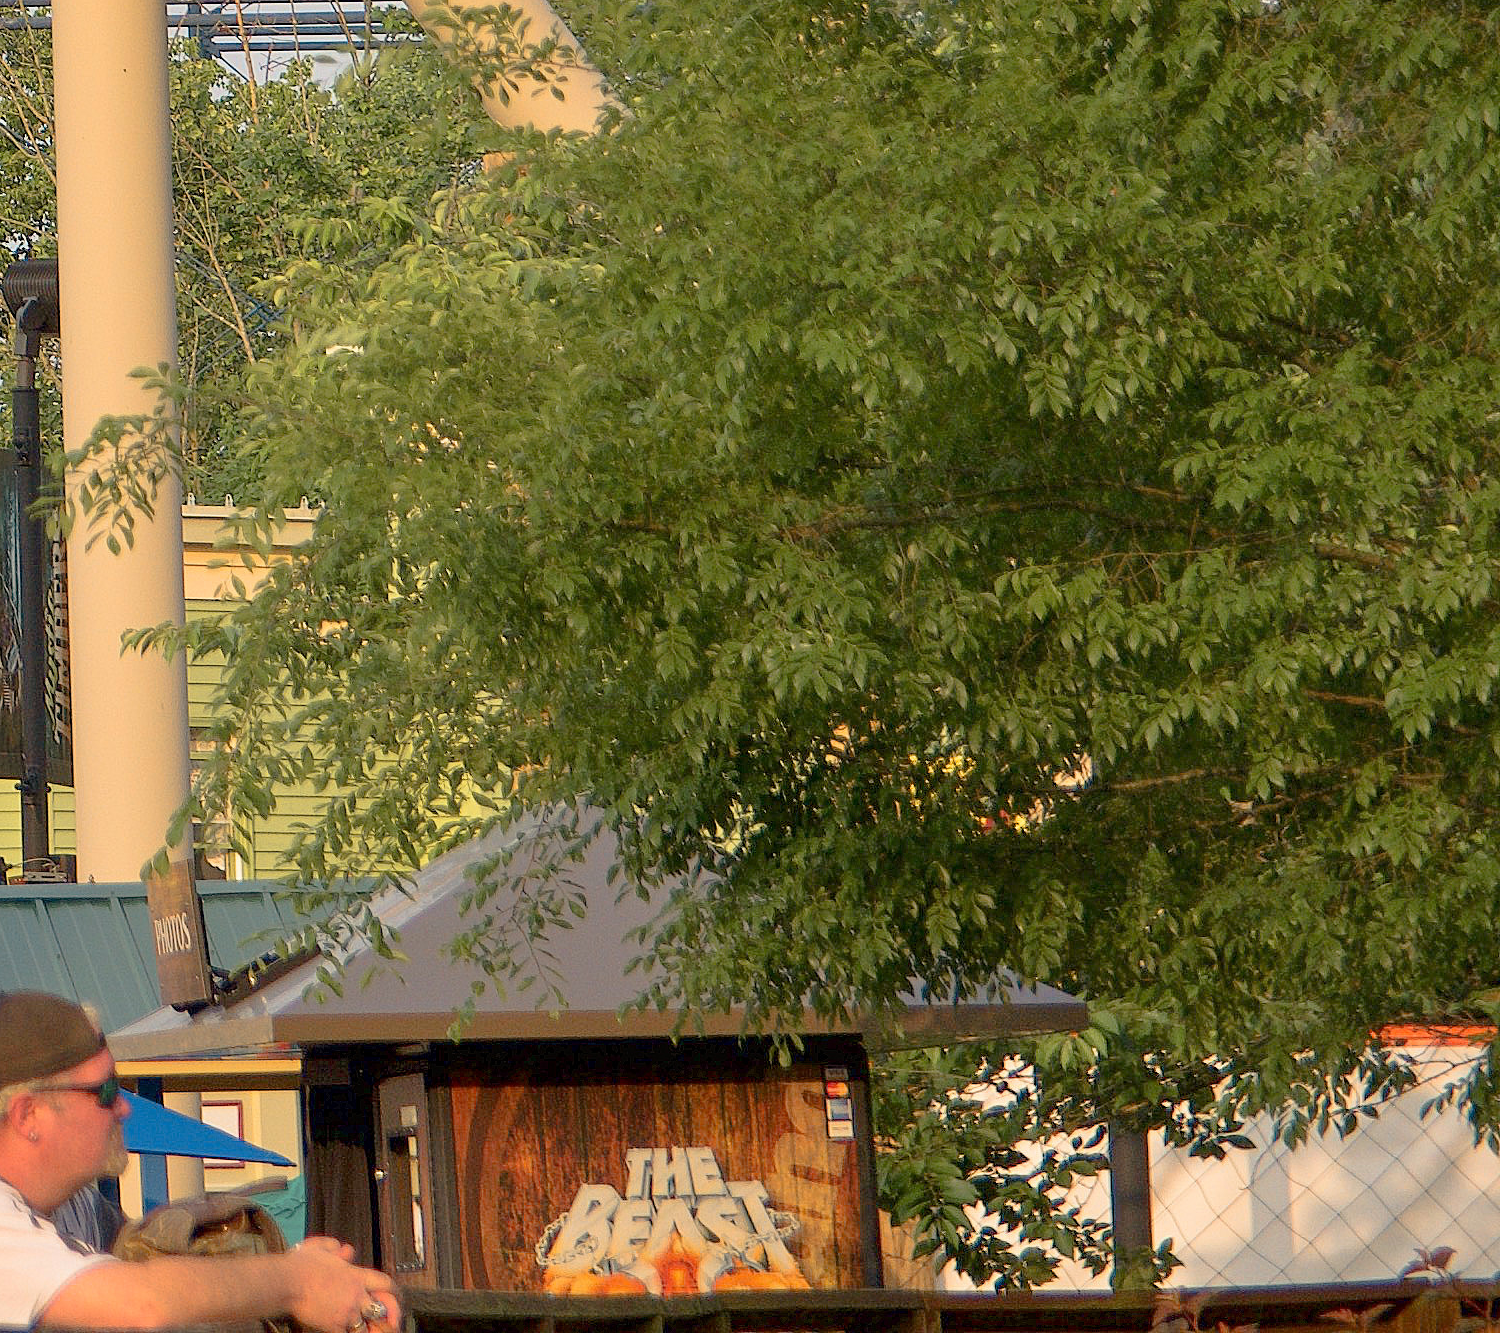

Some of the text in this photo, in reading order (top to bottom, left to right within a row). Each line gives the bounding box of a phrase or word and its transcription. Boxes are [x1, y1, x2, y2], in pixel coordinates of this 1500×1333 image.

[154, 912, 191, 955] PHOTOS
[625, 1146, 730, 1201] THE
[543, 1180, 812, 1295] BEAST
